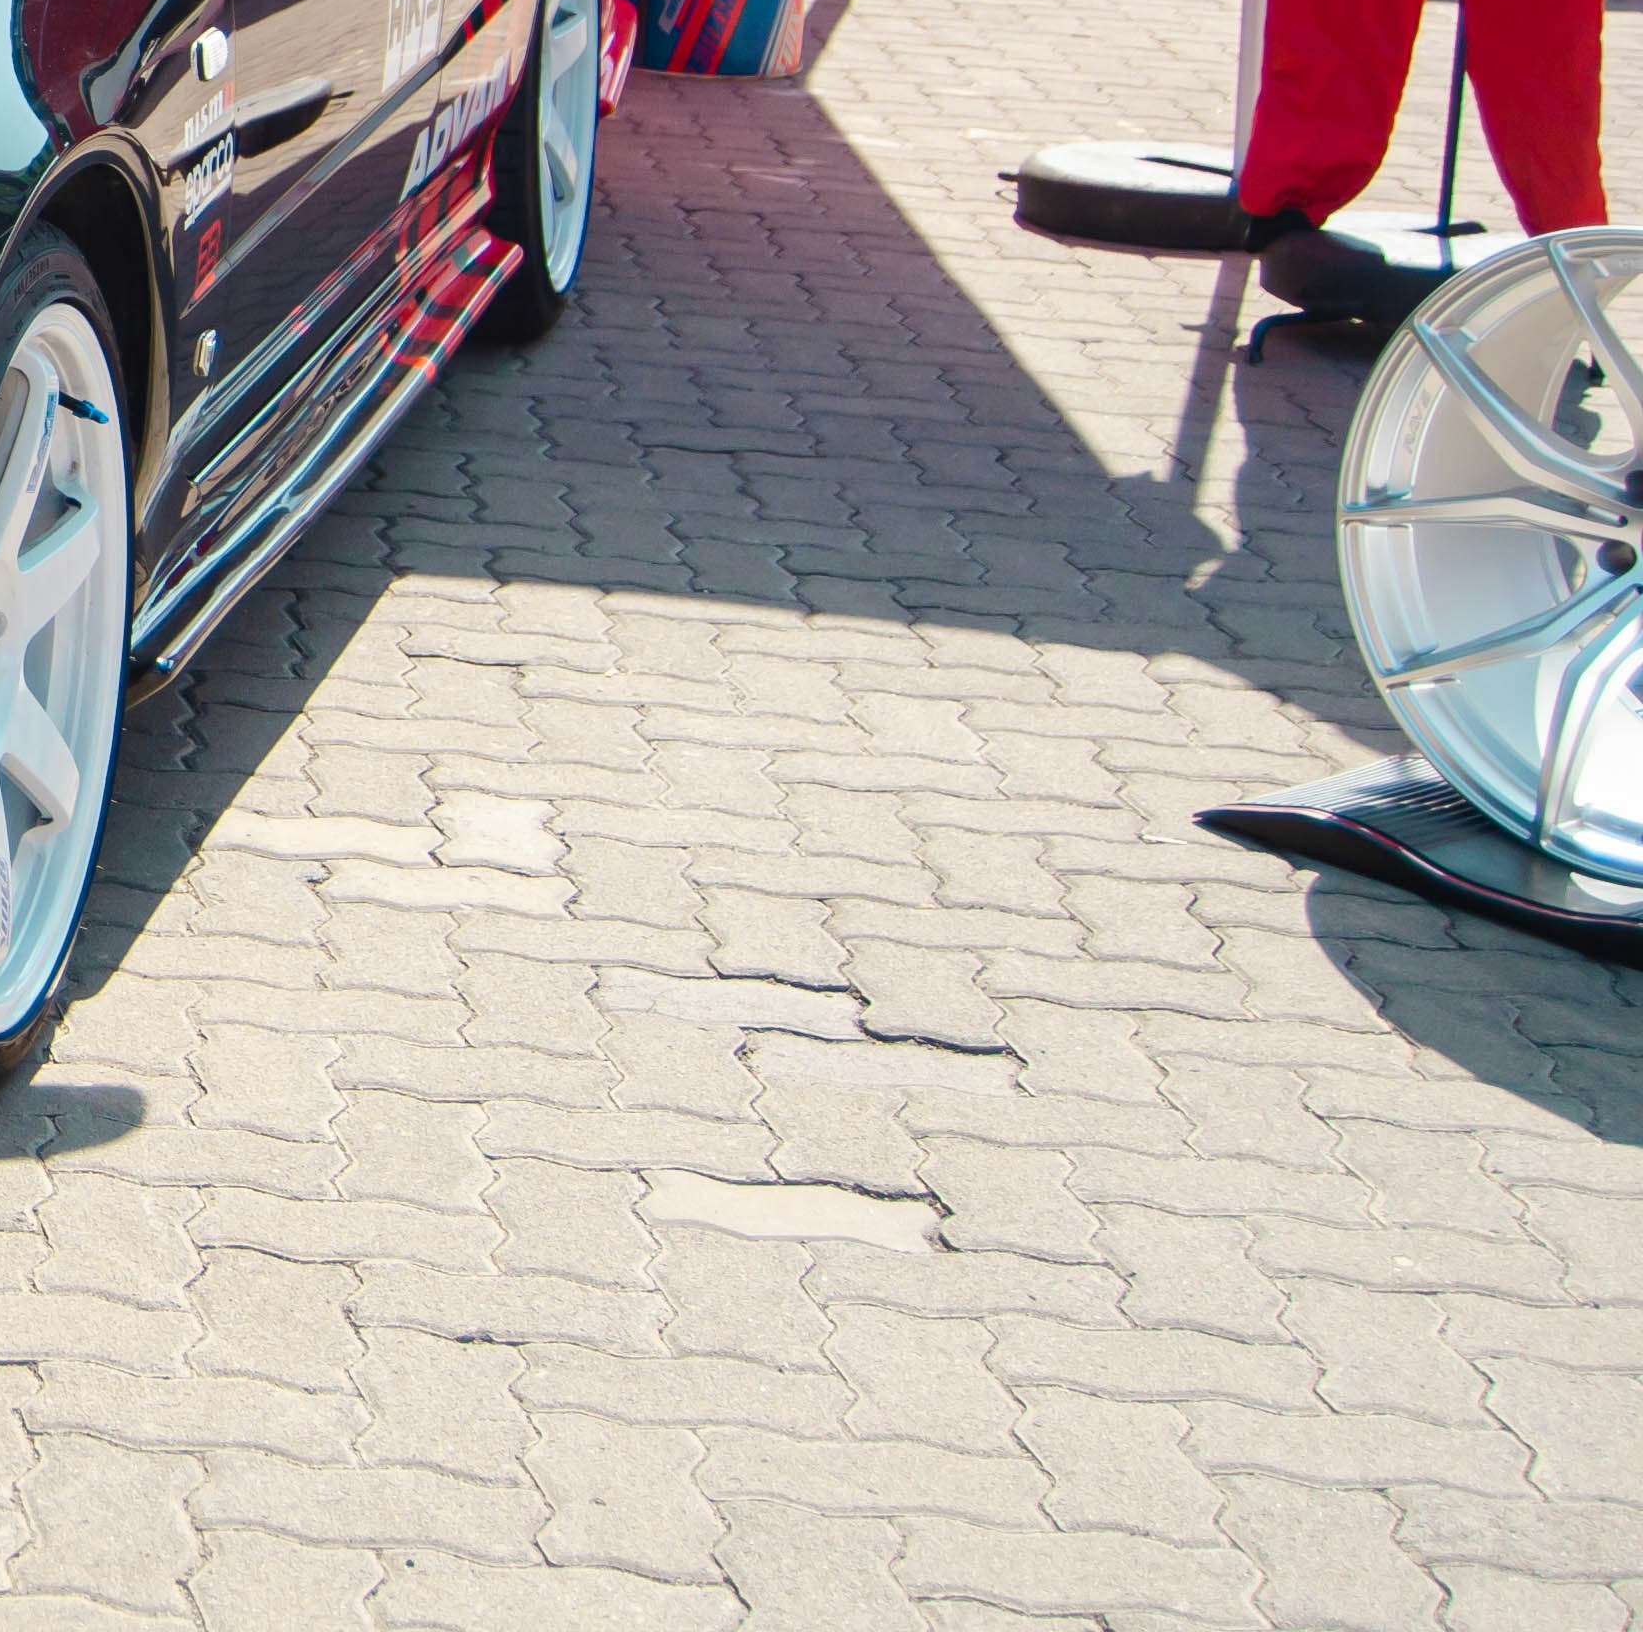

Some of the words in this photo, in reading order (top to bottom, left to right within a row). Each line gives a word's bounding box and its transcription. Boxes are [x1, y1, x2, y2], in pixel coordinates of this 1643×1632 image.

[183, 80, 234, 149] nismo
[399, 48, 515, 204] ADVAN
[184, 132, 233, 229] sparco
